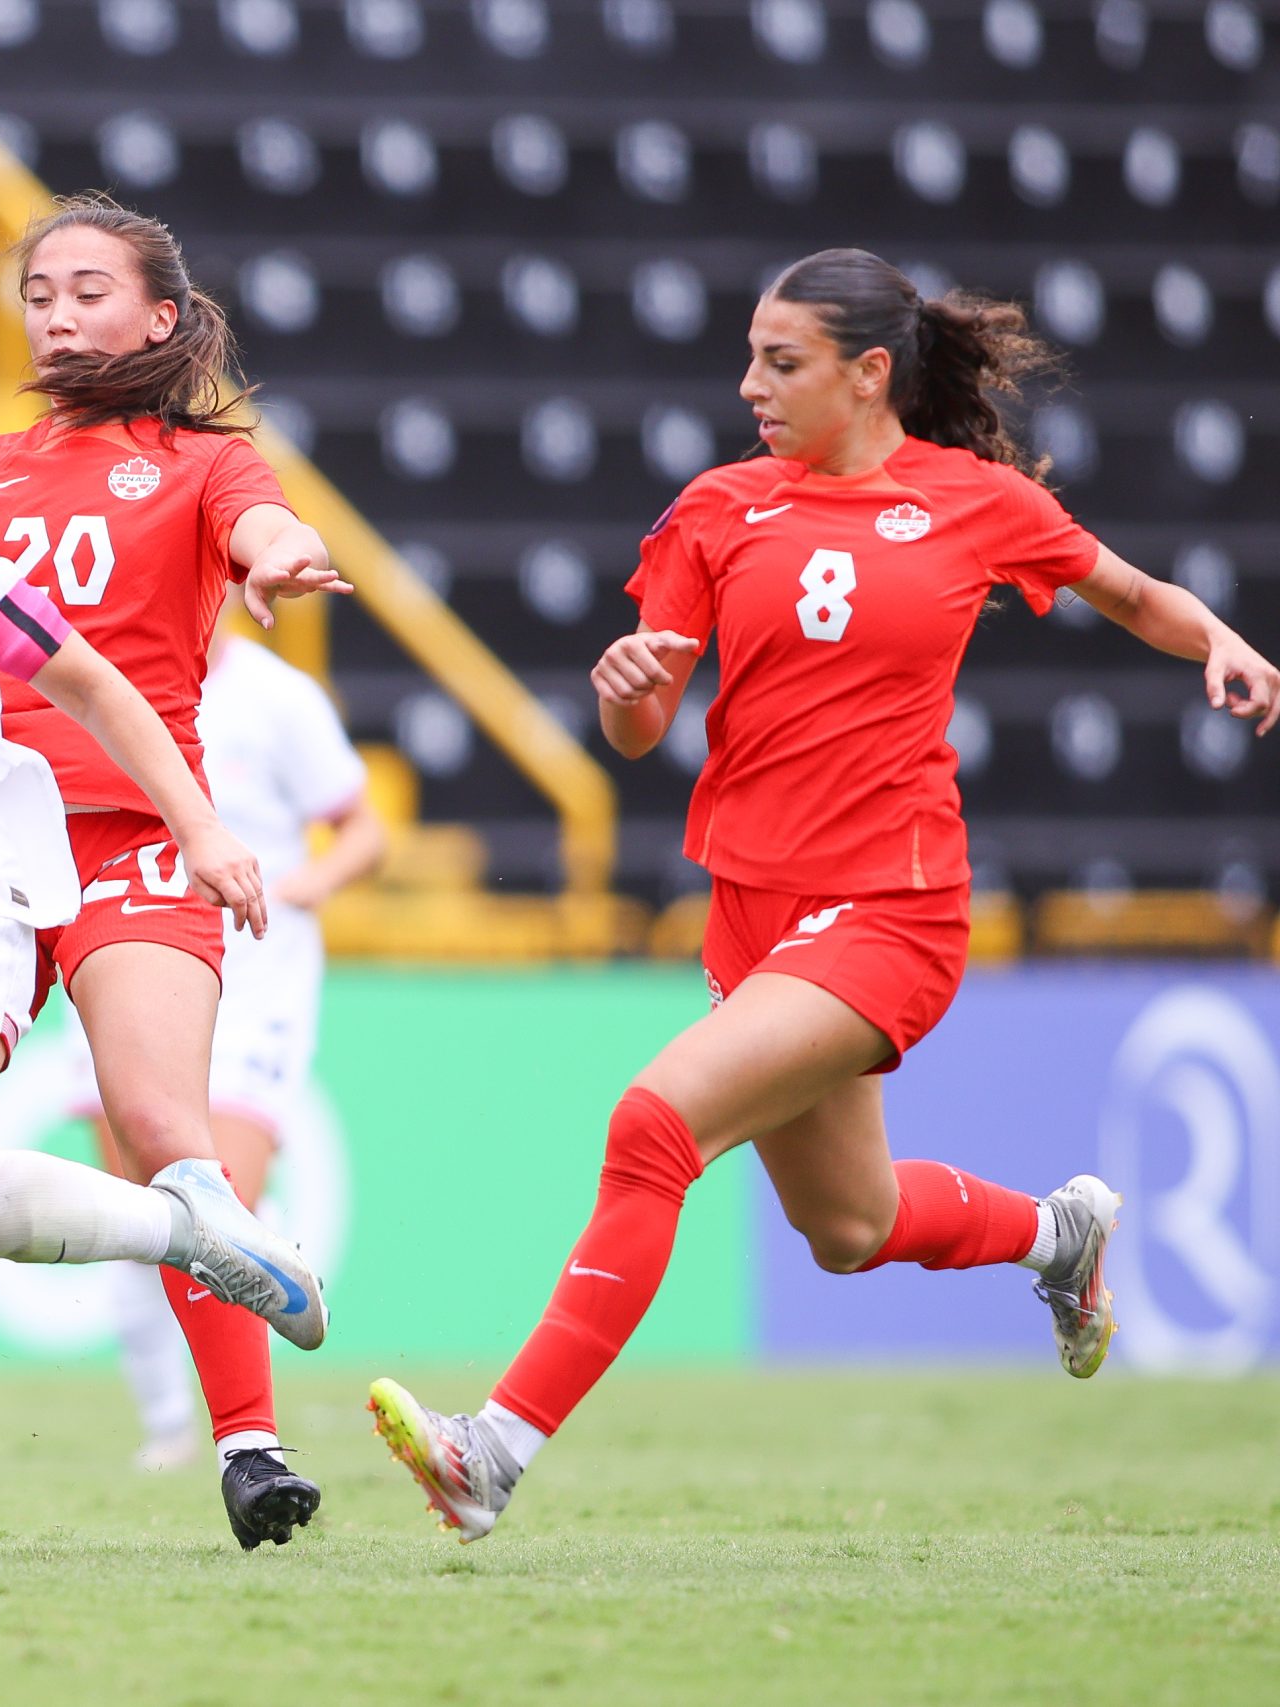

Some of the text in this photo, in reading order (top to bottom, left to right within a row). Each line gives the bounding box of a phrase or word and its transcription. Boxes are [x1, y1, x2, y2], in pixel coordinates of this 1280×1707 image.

[109, 475, 158, 483] CANADA
[4, 515, 116, 605] 20
[795, 548, 857, 642] 8
